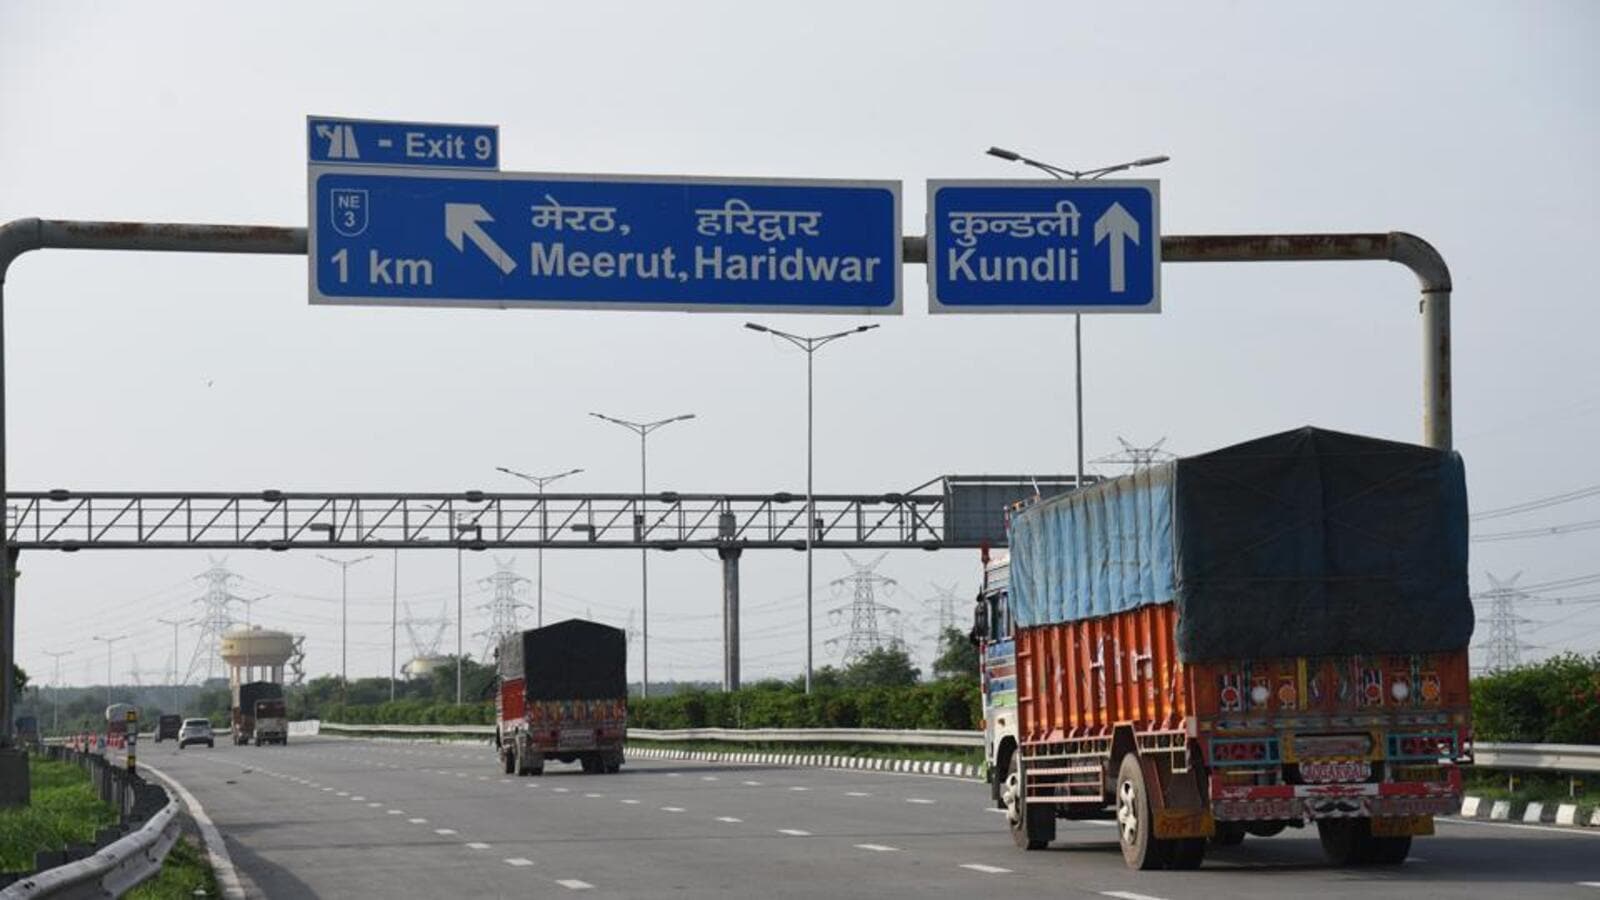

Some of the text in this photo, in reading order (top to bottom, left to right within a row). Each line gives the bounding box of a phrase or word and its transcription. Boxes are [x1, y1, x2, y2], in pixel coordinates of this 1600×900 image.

[407, 132, 466, 159] Exit
[474, 135, 491, 160] 9
[339, 195, 360, 208] NE
[344, 210, 356, 227] 3
[530, 194, 822, 241] मेरठ, हरिद्वार
[948, 200, 1081, 247] कुन्डली
[331, 249, 433, 285] 1 km
[530, 242, 881, 282] Meerut, Haridwar
[948, 248, 1079, 281] Kundli
